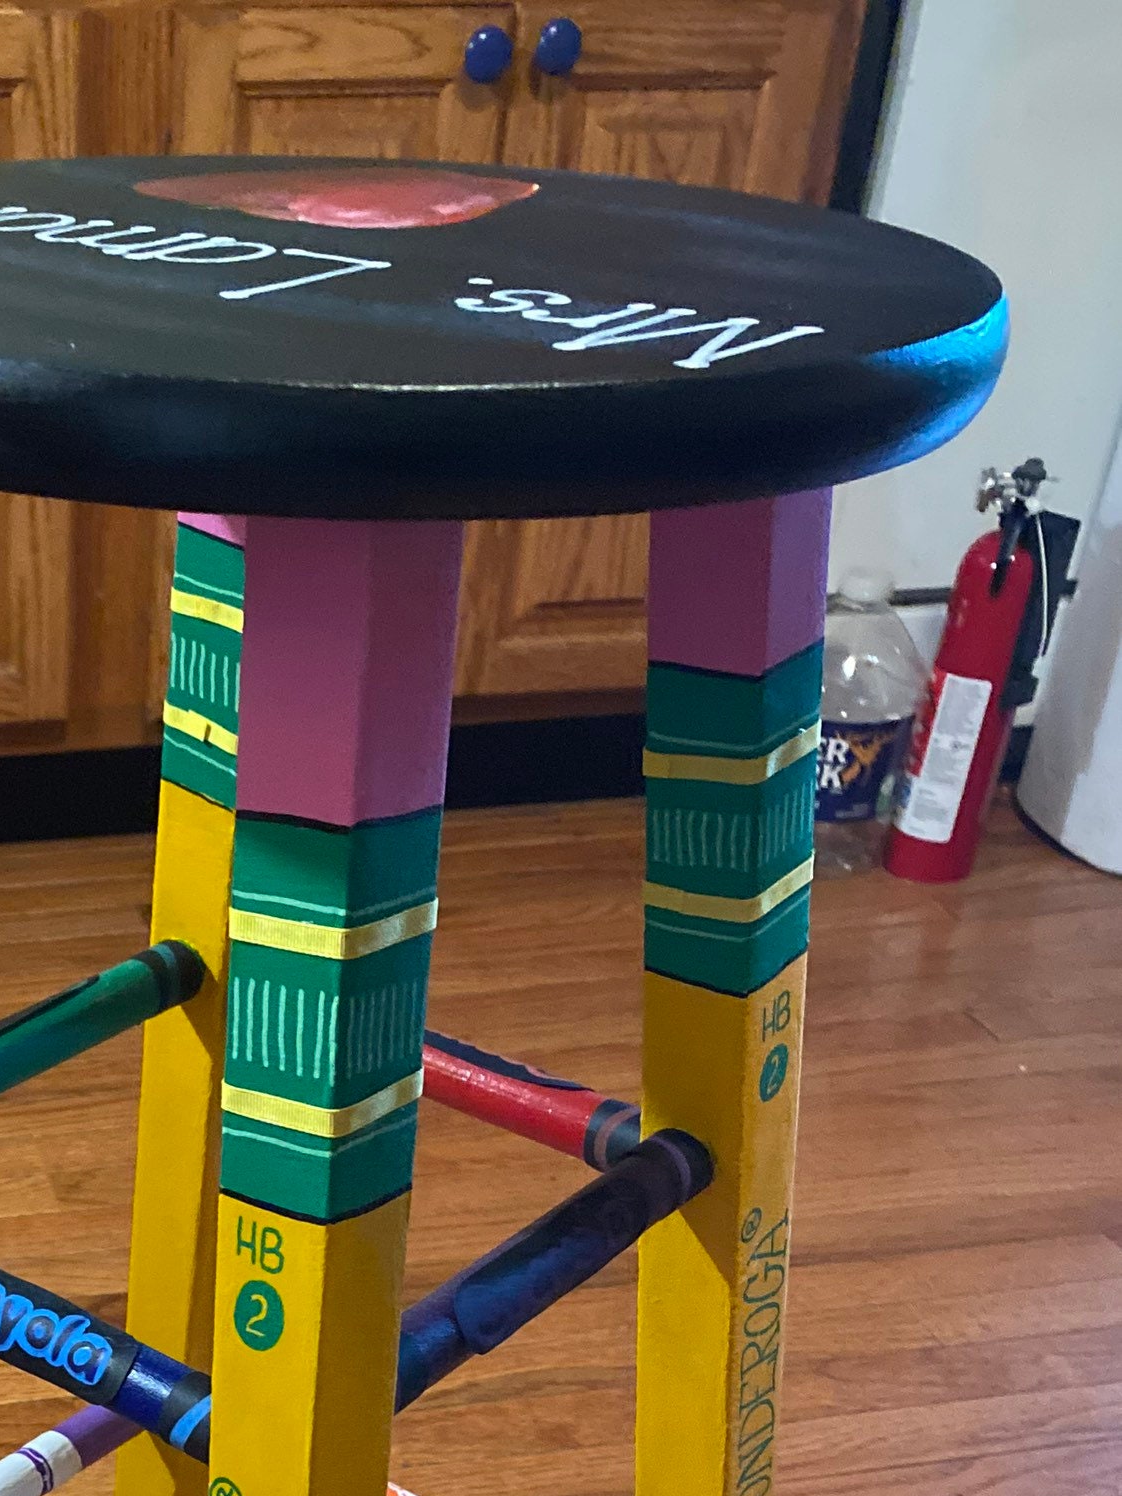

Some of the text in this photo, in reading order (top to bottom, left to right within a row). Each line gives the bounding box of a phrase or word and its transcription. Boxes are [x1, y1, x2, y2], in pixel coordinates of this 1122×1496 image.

[454, 277, 826, 370] Mrs.
[762, 989, 791, 1043] HB
[236, 1215, 285, 1275] HB
